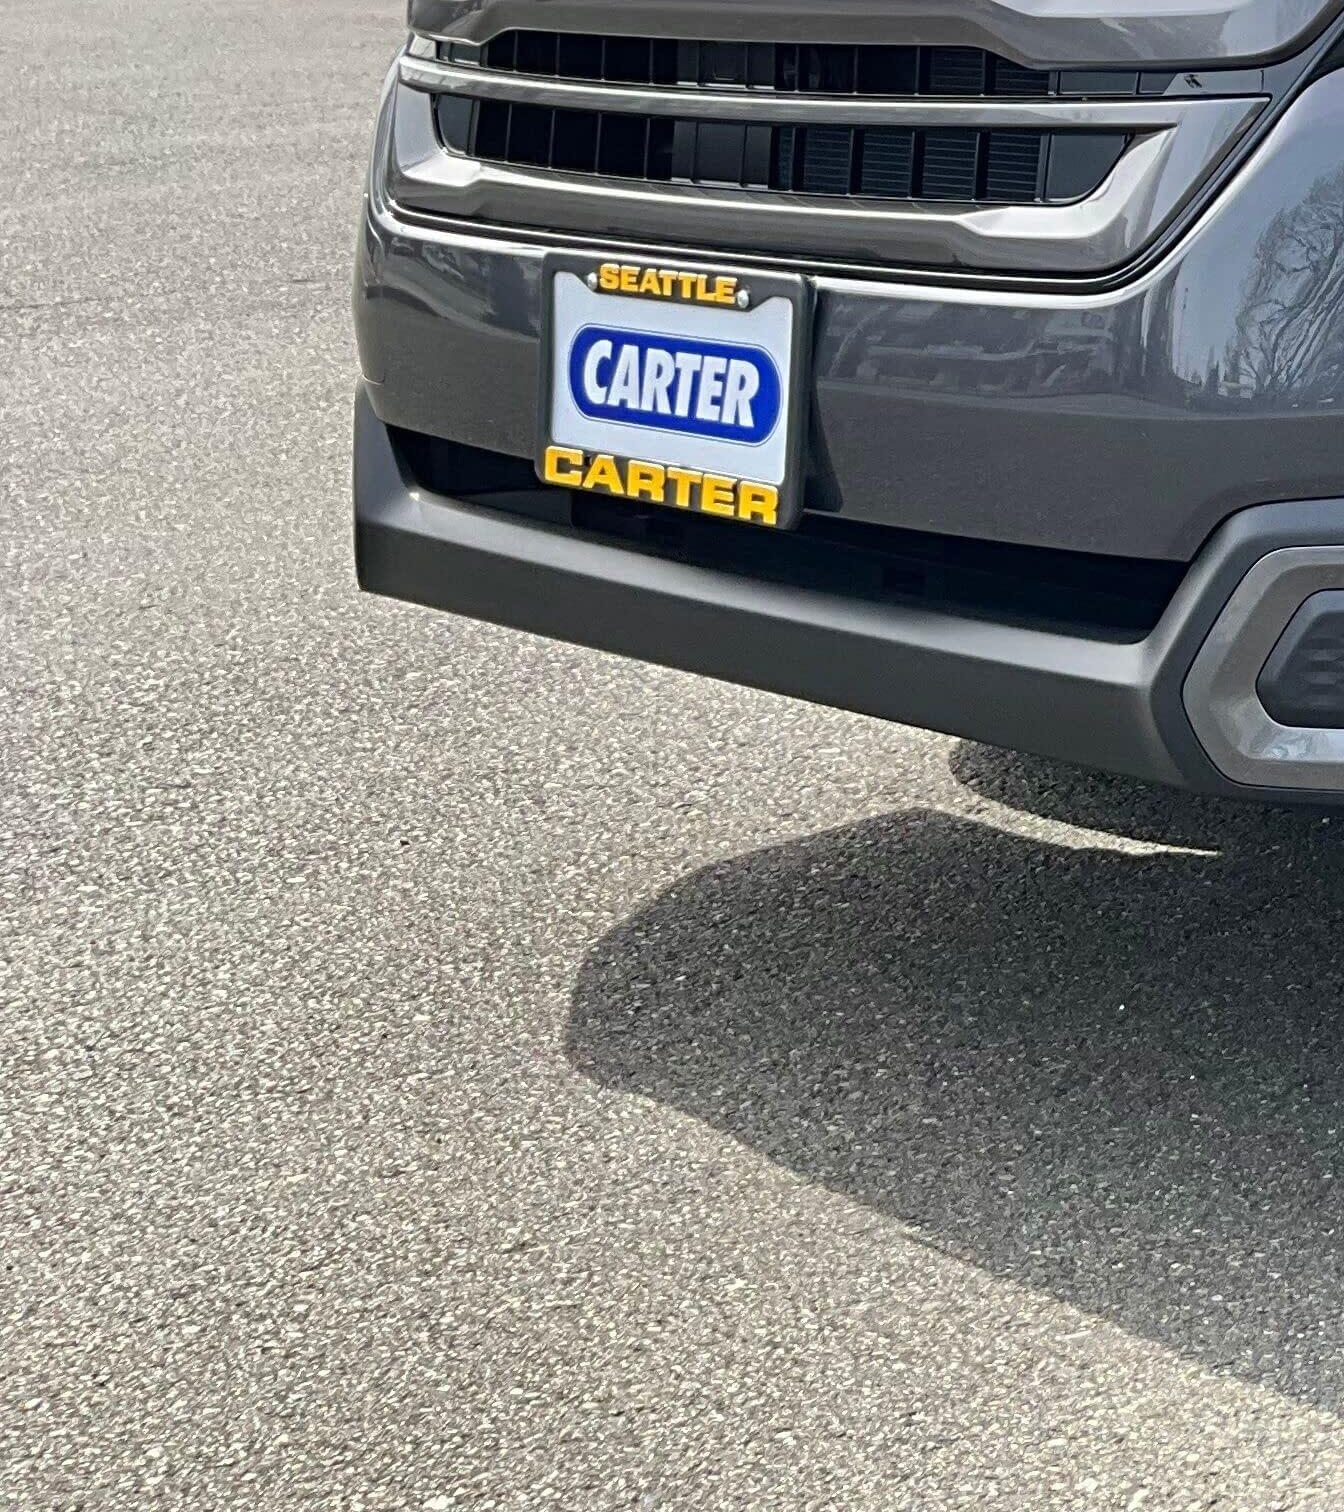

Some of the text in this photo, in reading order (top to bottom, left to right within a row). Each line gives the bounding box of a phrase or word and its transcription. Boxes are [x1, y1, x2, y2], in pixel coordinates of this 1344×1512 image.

[599, 262, 738, 305] SEATTLE
[583, 339, 760, 428] CARTER
[544, 444, 779, 526] CARTER
